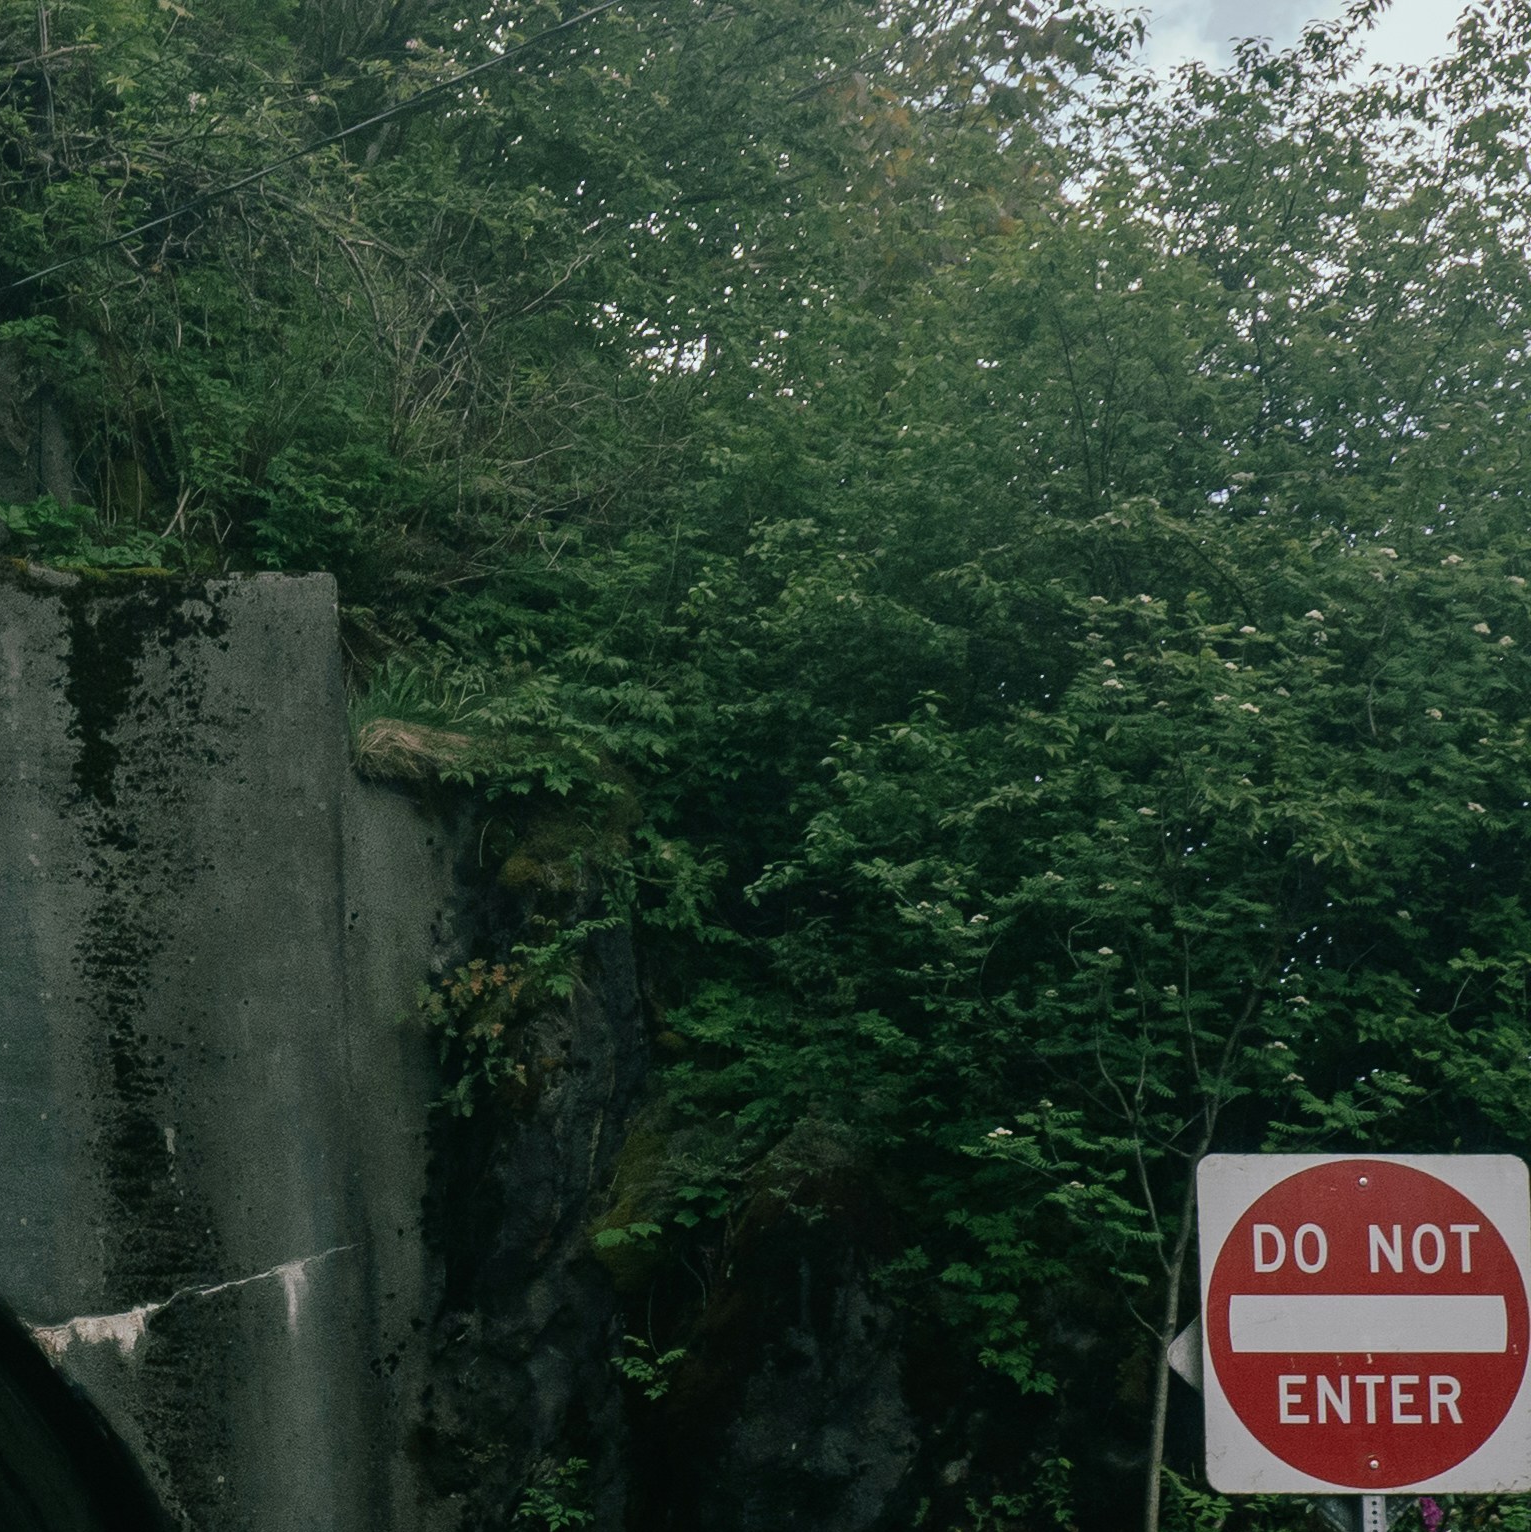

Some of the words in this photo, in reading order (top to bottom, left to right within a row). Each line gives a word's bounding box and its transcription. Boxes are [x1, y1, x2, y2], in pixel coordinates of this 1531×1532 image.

[1252, 1222, 1329, 1275] DO
[1367, 1222, 1481, 1275] NOT
[1277, 1374, 1465, 1425] ENTER
